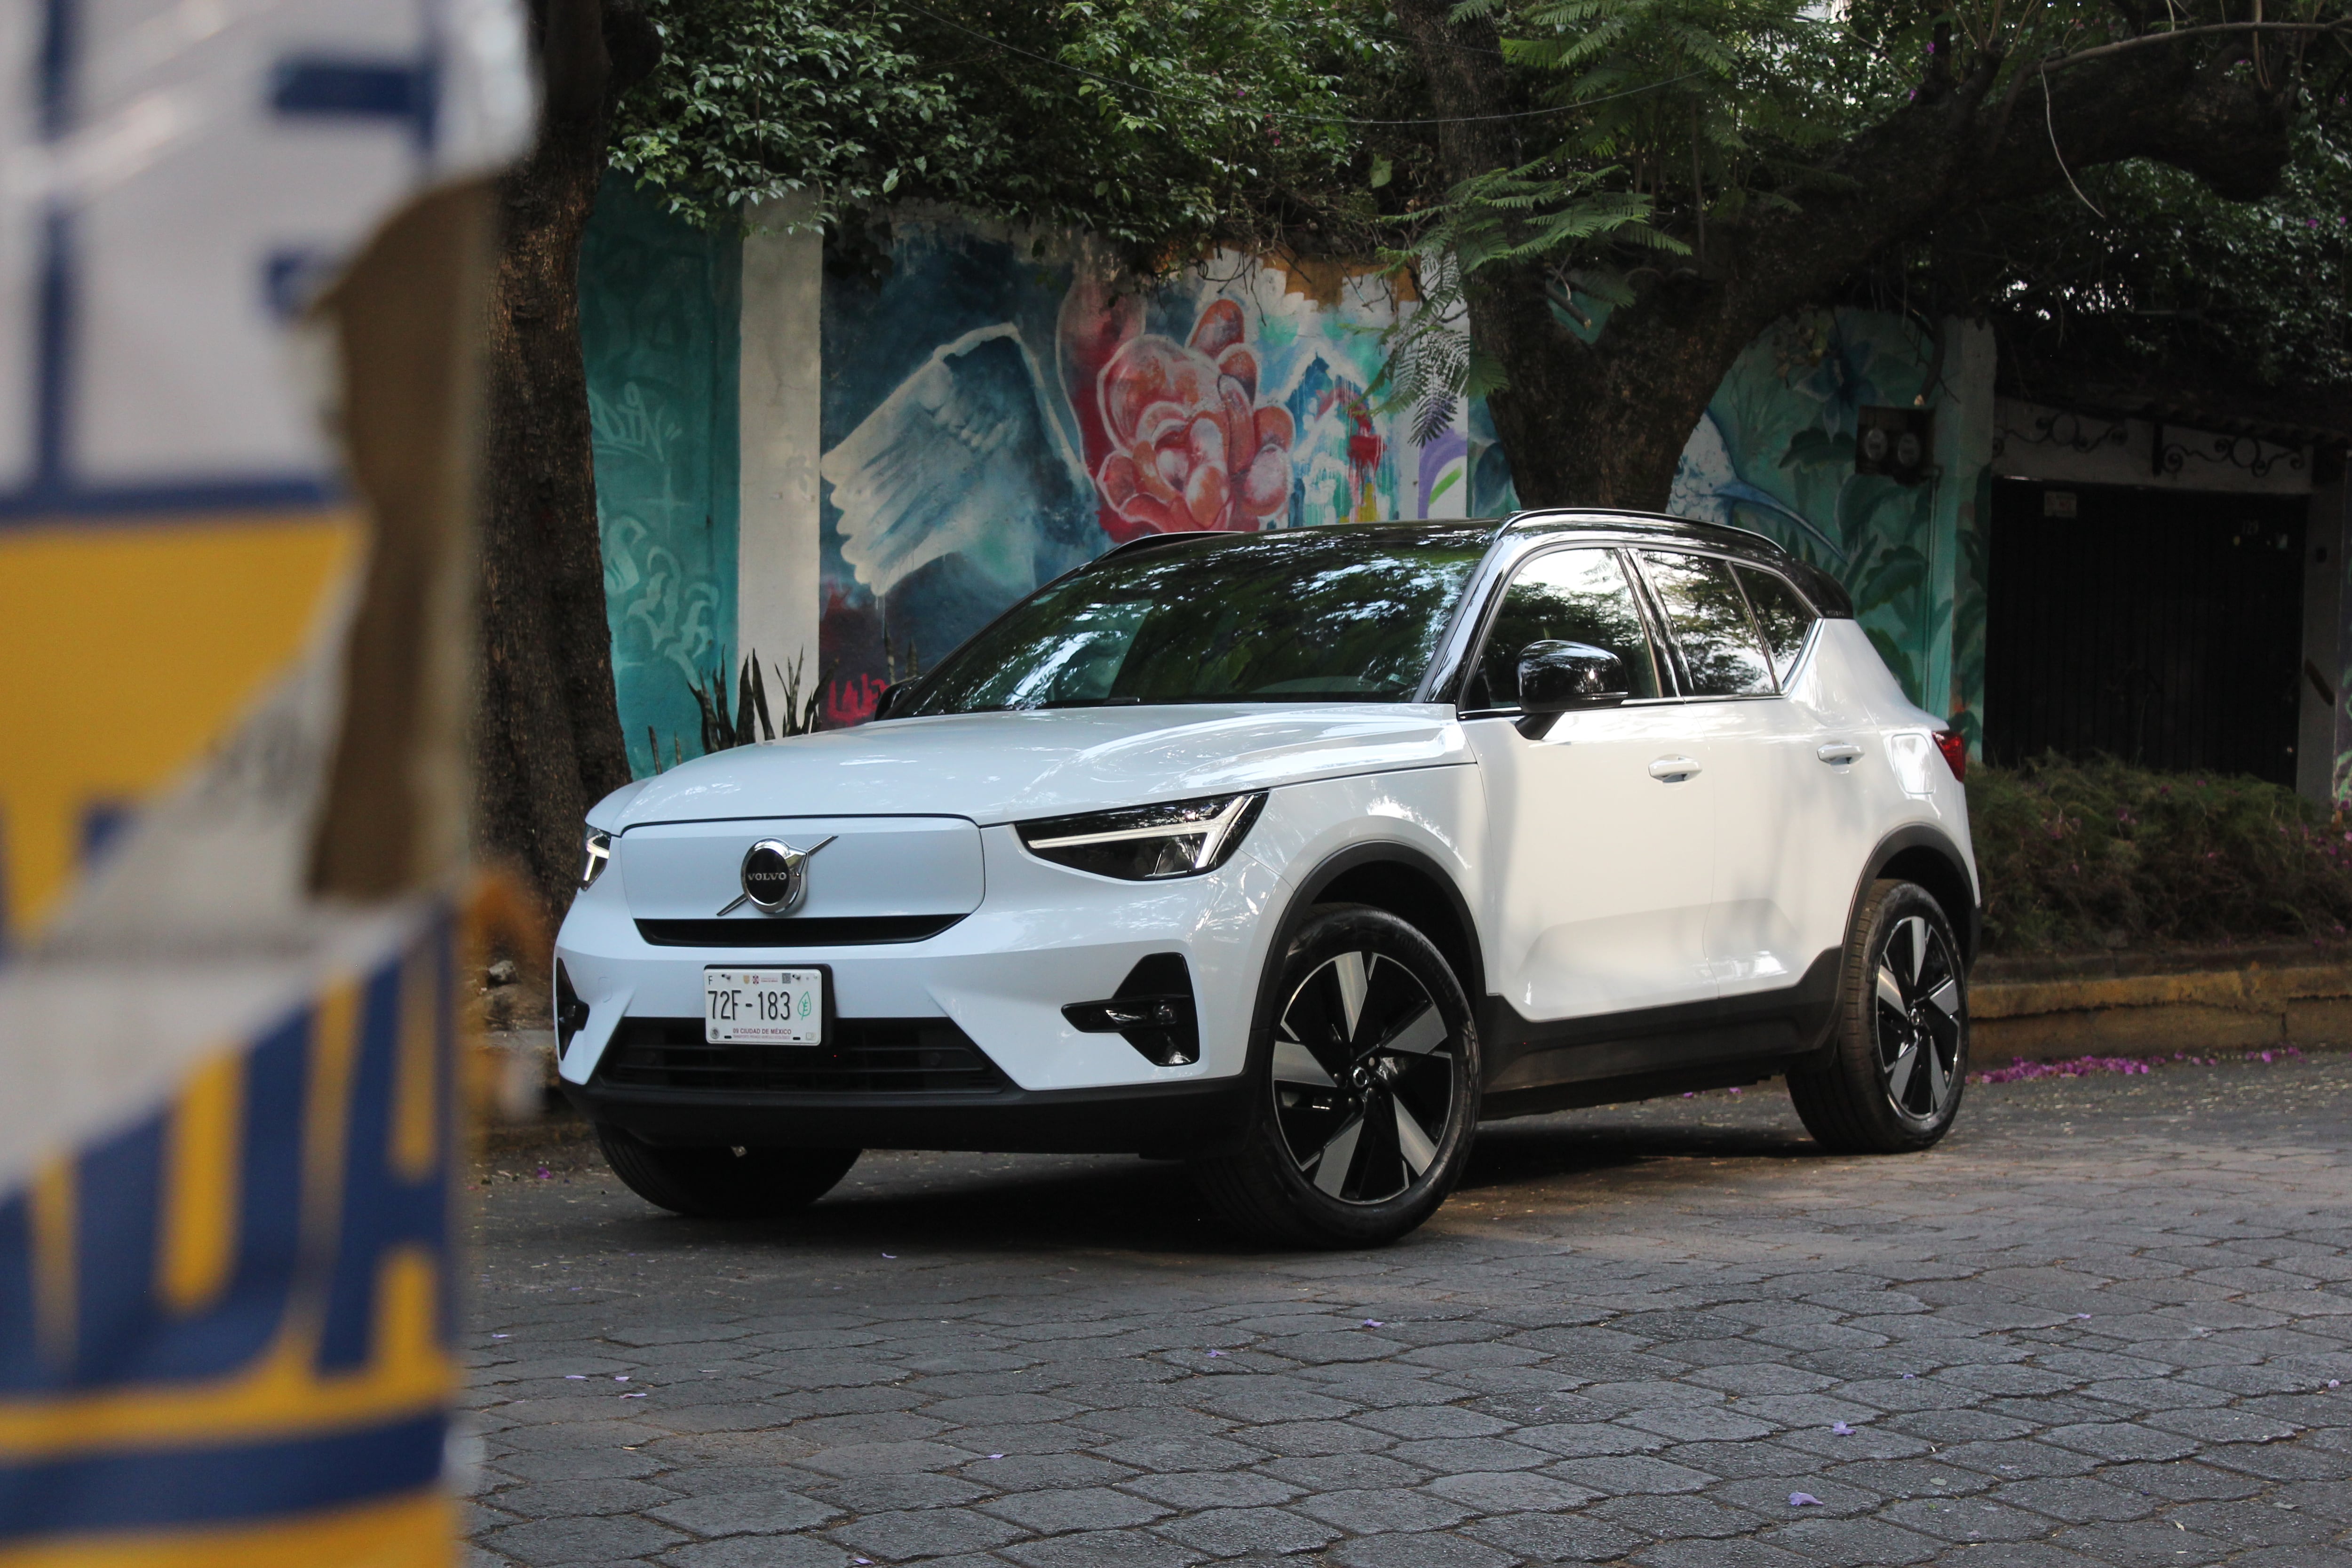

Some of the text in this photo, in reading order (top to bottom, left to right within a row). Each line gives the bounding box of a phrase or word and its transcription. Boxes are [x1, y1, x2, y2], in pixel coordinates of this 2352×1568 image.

[747, 872, 787, 881] VOLVO
[708, 976, 713, 985] F
[708, 990, 791, 1020] 72F-183
